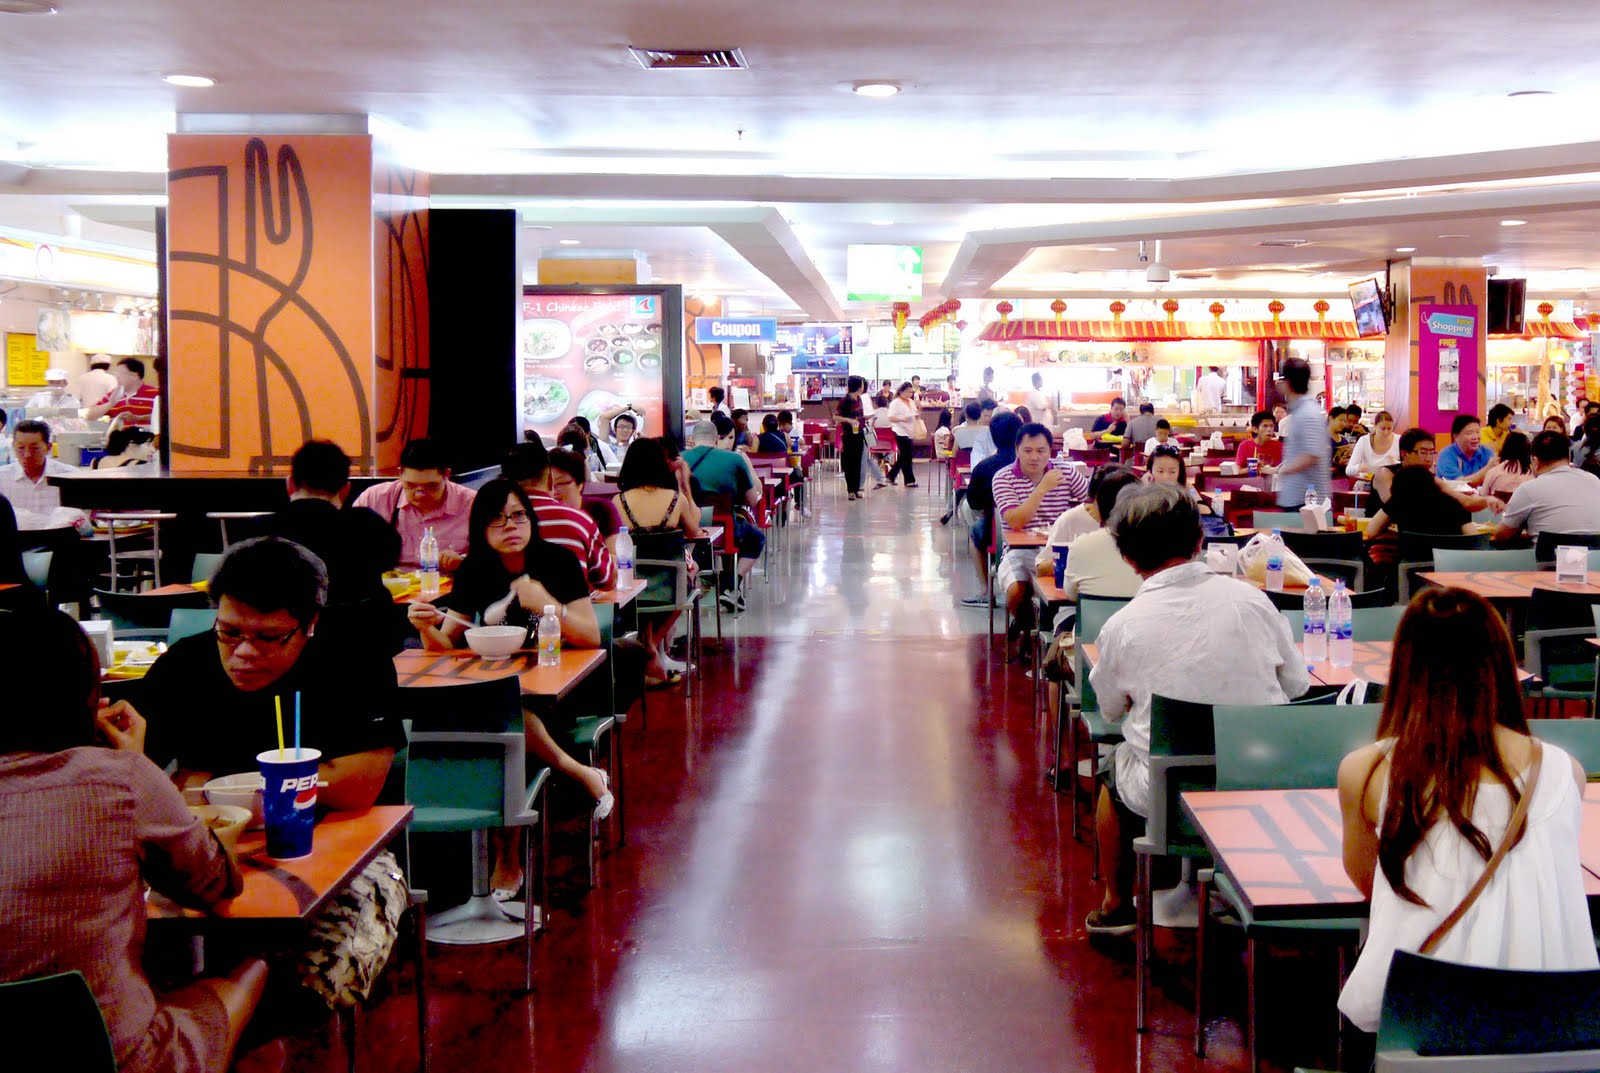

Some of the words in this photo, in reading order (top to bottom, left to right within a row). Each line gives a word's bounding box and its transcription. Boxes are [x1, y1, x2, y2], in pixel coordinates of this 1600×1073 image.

[546, 301, 589, 312] Chinese
[711, 321, 761, 337] Coupon
[1432, 321, 1472, 335] Shopping
[1439, 338, 1457, 347] FREE
